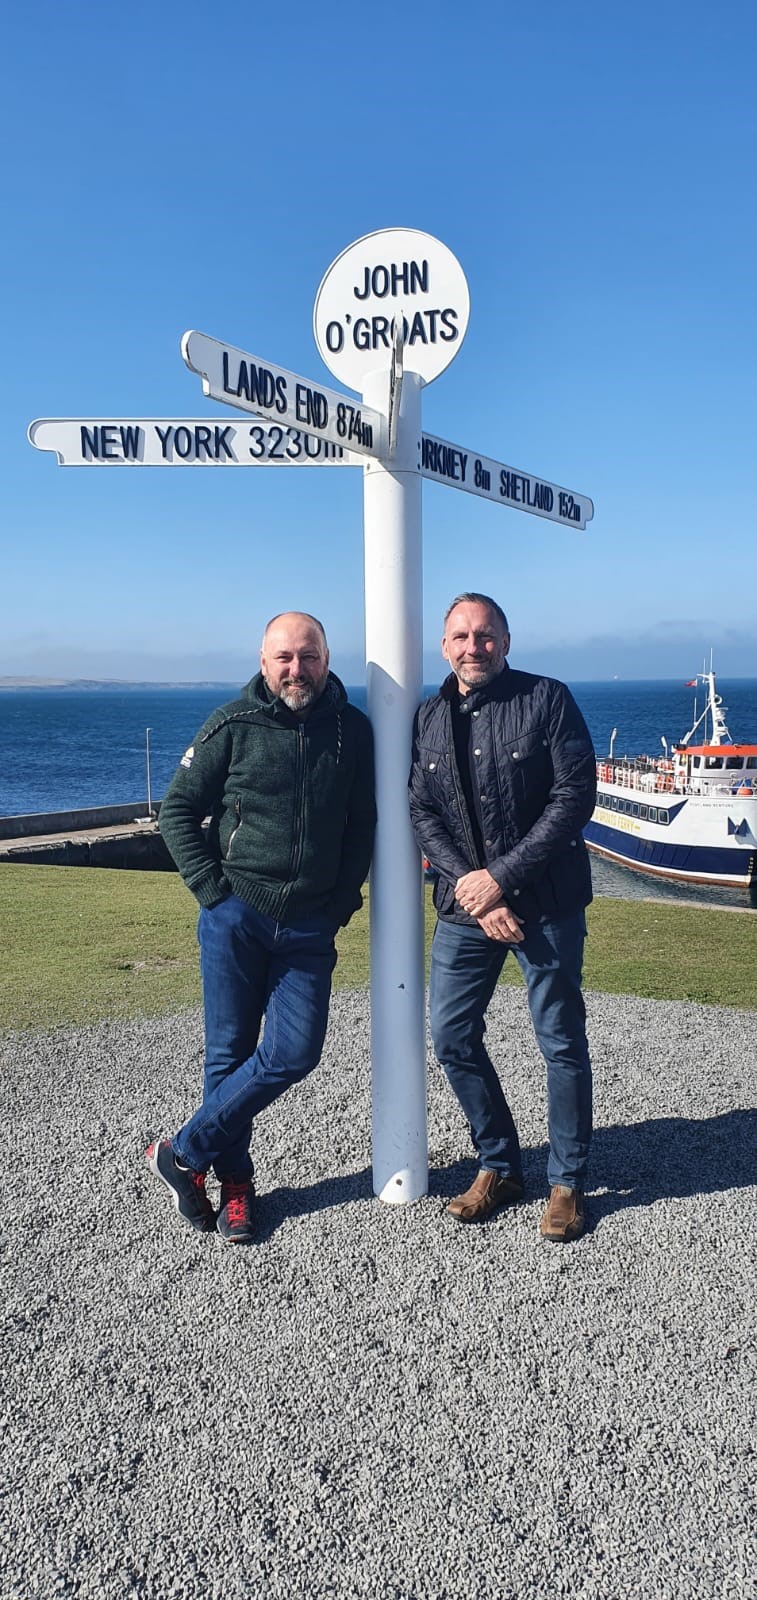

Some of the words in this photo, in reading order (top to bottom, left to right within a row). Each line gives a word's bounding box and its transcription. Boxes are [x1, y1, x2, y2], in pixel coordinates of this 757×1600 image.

[353, 259, 429, 301] JOHN
[325, 308, 459, 353] O'GROATS
[222, 351, 288, 414] LANDS
[295, 383, 329, 429] END
[336, 402, 373, 448] 874m
[80, 425, 141, 459] NEW
[154, 425, 234, 459] YORK
[249, 425, 344, 459] 3230m
[474, 459, 491, 491] 8m
[499, 469, 554, 512] SHETLAND
[558, 491, 581, 522] 152m
